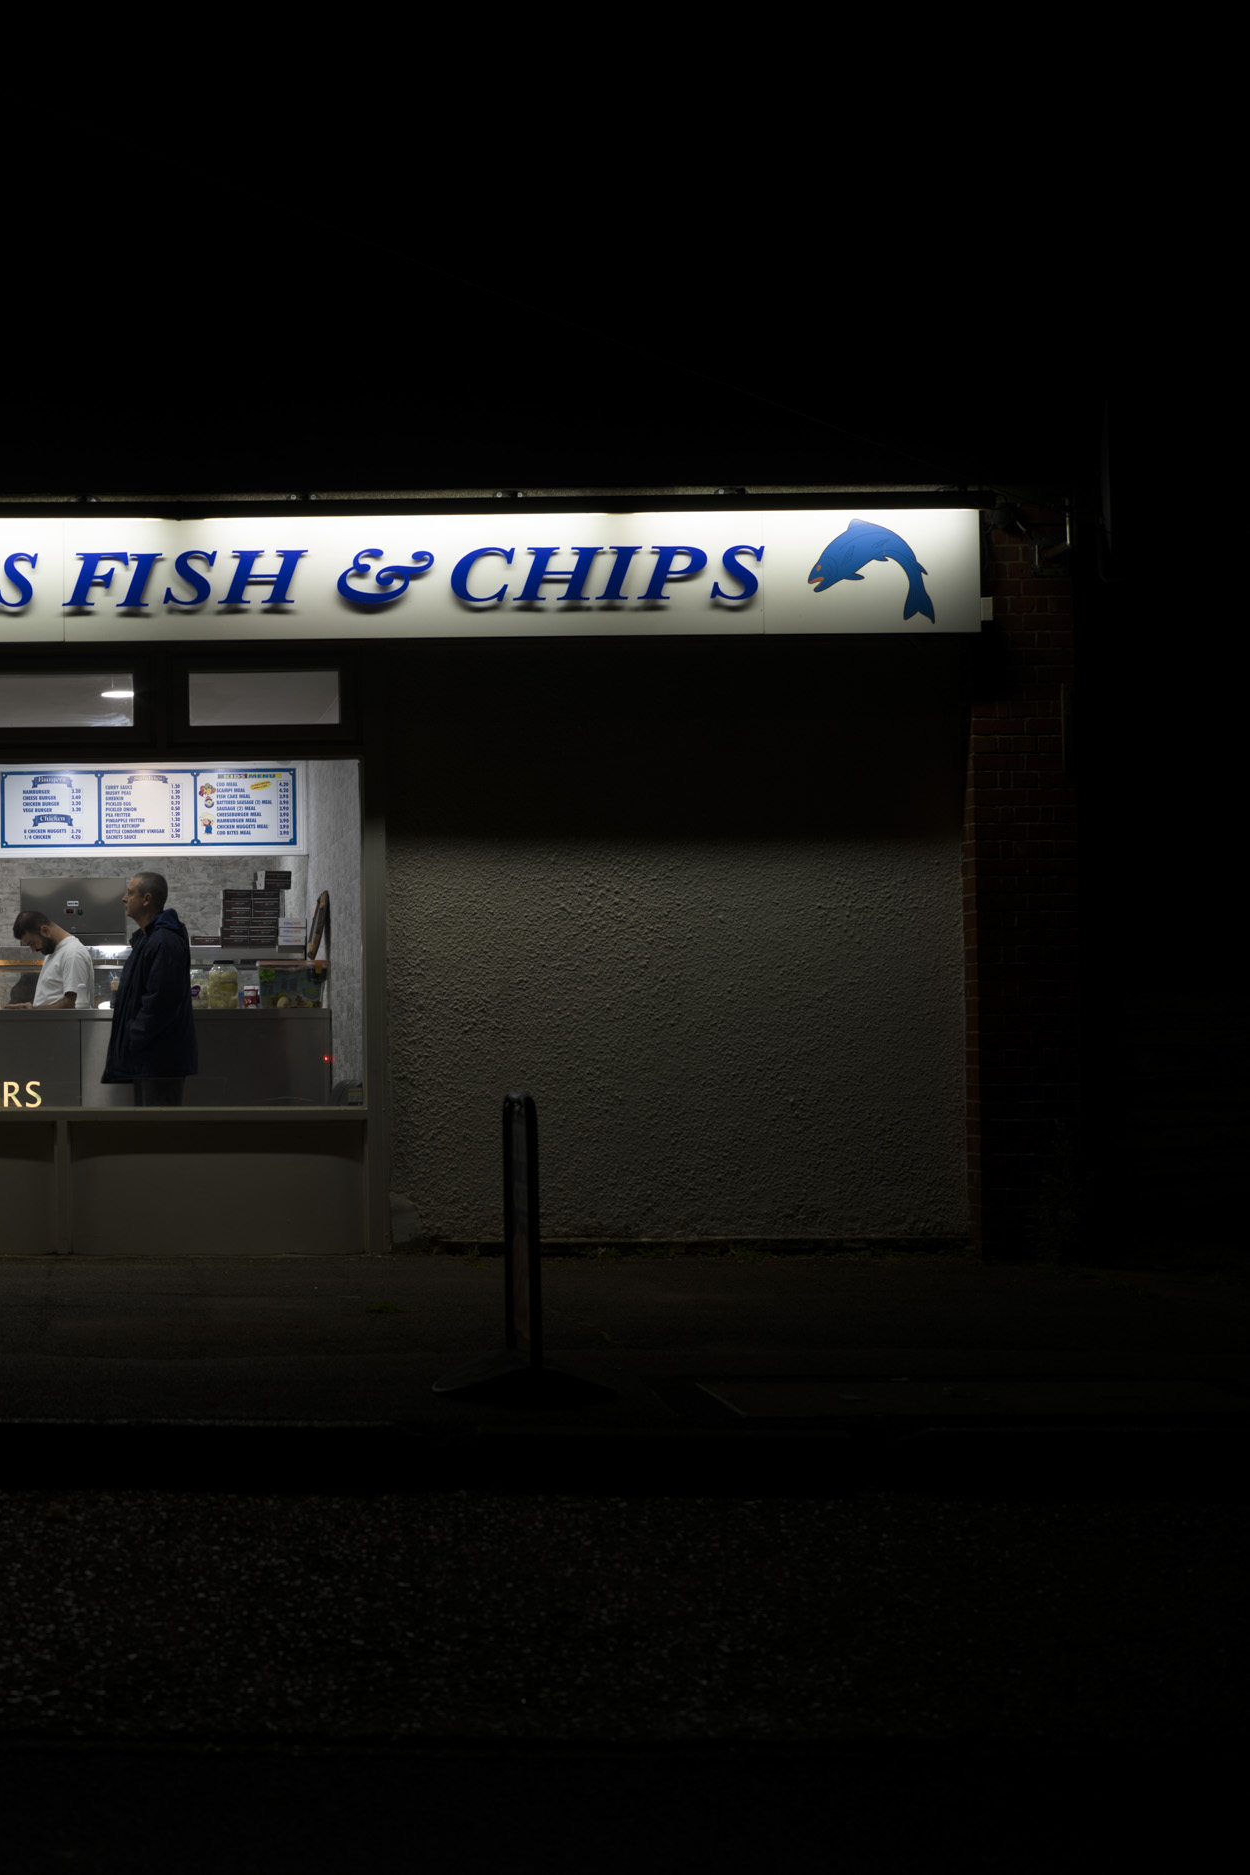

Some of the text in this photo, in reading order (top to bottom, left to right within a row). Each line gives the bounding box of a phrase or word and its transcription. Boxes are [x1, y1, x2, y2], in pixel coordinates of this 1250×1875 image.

[63, 549, 309, 608] FISH
[337, 548, 435, 602] &
[451, 544, 765, 602] CHIPS
